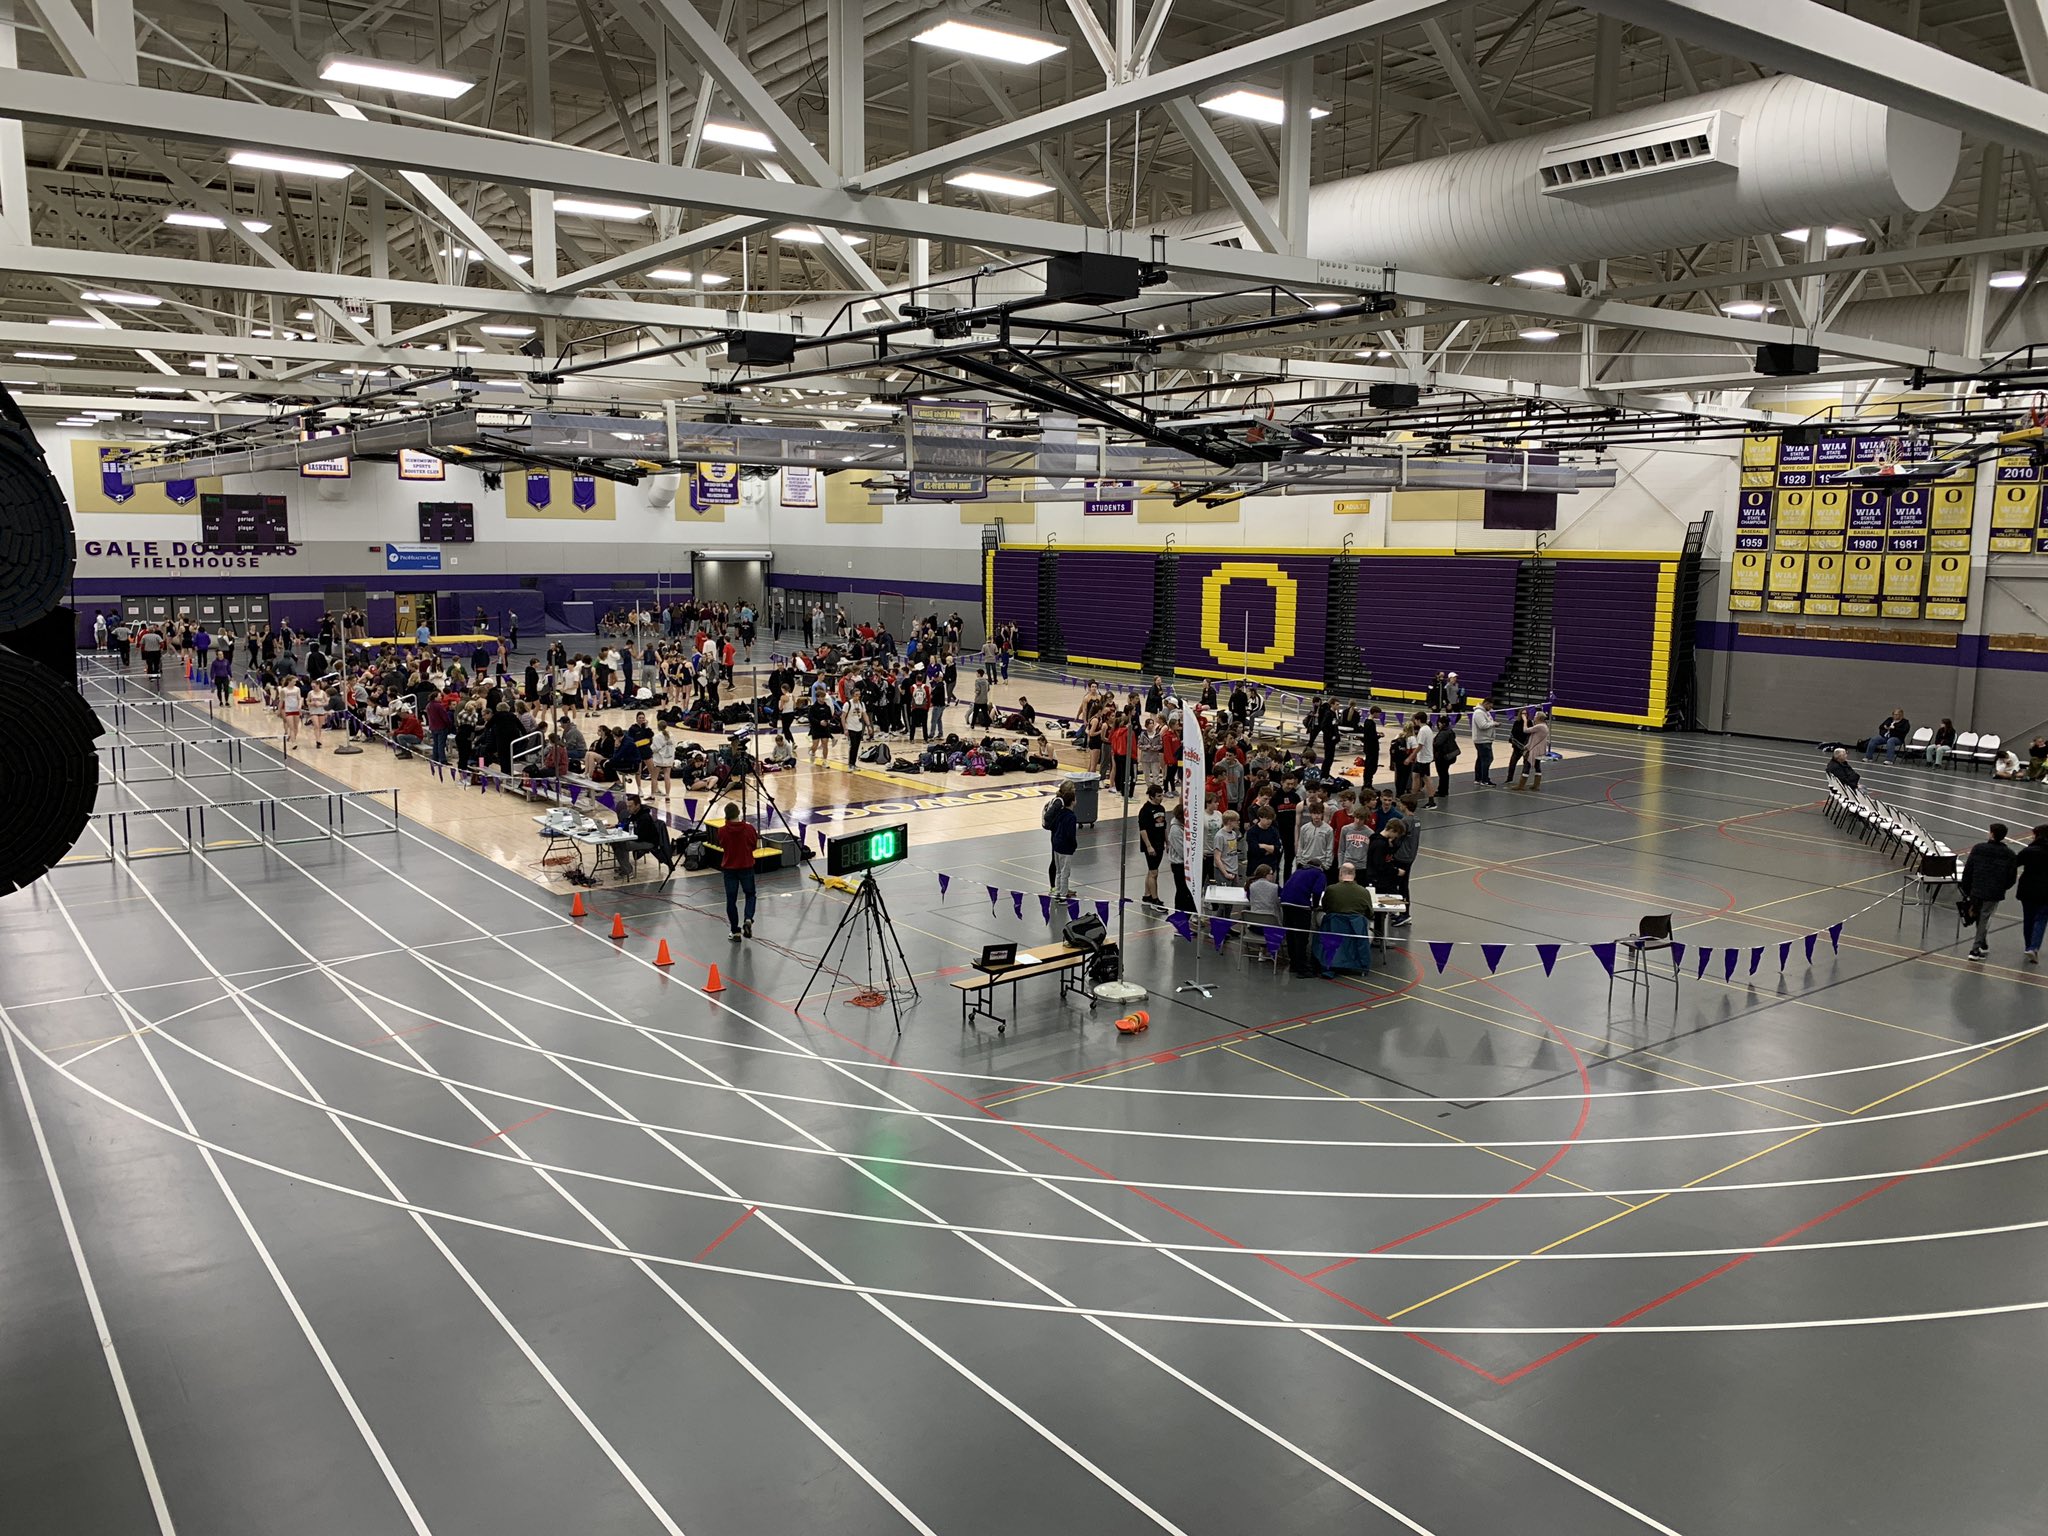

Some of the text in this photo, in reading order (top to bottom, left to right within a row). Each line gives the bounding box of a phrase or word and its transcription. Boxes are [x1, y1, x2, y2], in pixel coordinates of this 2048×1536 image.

[1783, 475, 1806, 484] 1928
[2004, 468, 2033, 478] 2010
[1748, 492, 1764, 506] O
[1787, 492, 1803, 506] O
[1822, 492, 1837, 506] O
[1861, 491, 1878, 505] O
[1901, 490, 1919, 505] O
[1945, 489, 1962, 503] O
[2007, 487, 2026, 502] O
[1091, 504, 1125, 512] STUDENTS
[85, 541, 159, 556] GALE
[1741, 539, 1763, 547] 1959
[1853, 540, 1878, 549] 1980
[1893, 540, 1918, 549] 1981
[131, 557, 259, 568] FIELDHOUSE
[1742, 554, 1756, 567] O
[1780, 556, 1795, 569] O
[1818, 556, 1833, 570] O
[1855, 557, 1871, 570] O
[1895, 557, 1912, 571] O
[1941, 557, 1958, 571] O
[1201, 562, 1297, 670] O
[210, 800, 253, 809] OCONOMOWOC
[133, 807, 179, 816] OCONOMOWOC
